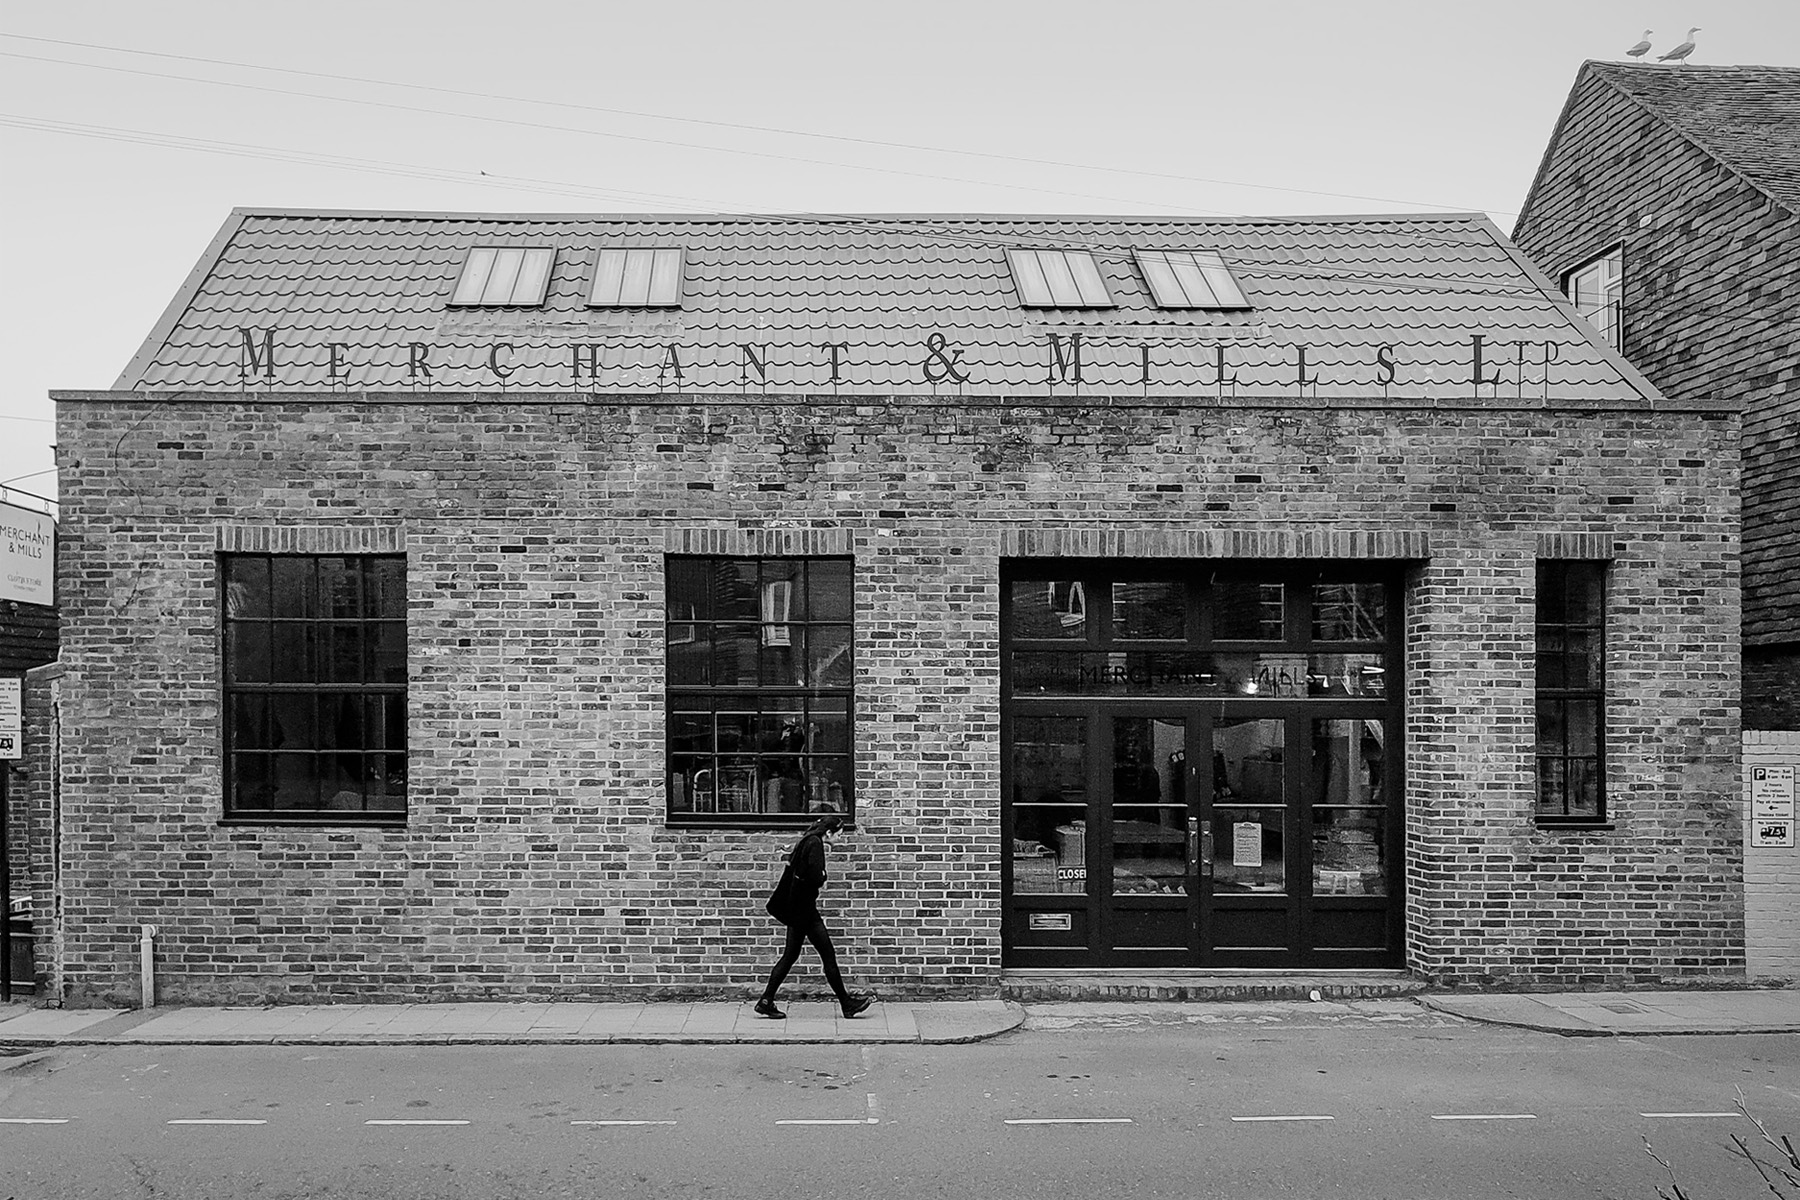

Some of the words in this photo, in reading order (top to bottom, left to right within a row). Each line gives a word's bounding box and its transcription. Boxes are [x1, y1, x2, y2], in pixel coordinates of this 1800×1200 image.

[238, 328, 849, 381] MERCHANT
[922, 333, 971, 383] &
[1046, 333, 1396, 384] MILLS
[0, 525, 50, 546] MERCHANT
[9, 542, 15, 553] &
[17, 543, 43, 559] MILLS
[1756, 769, 1765, 780] P
